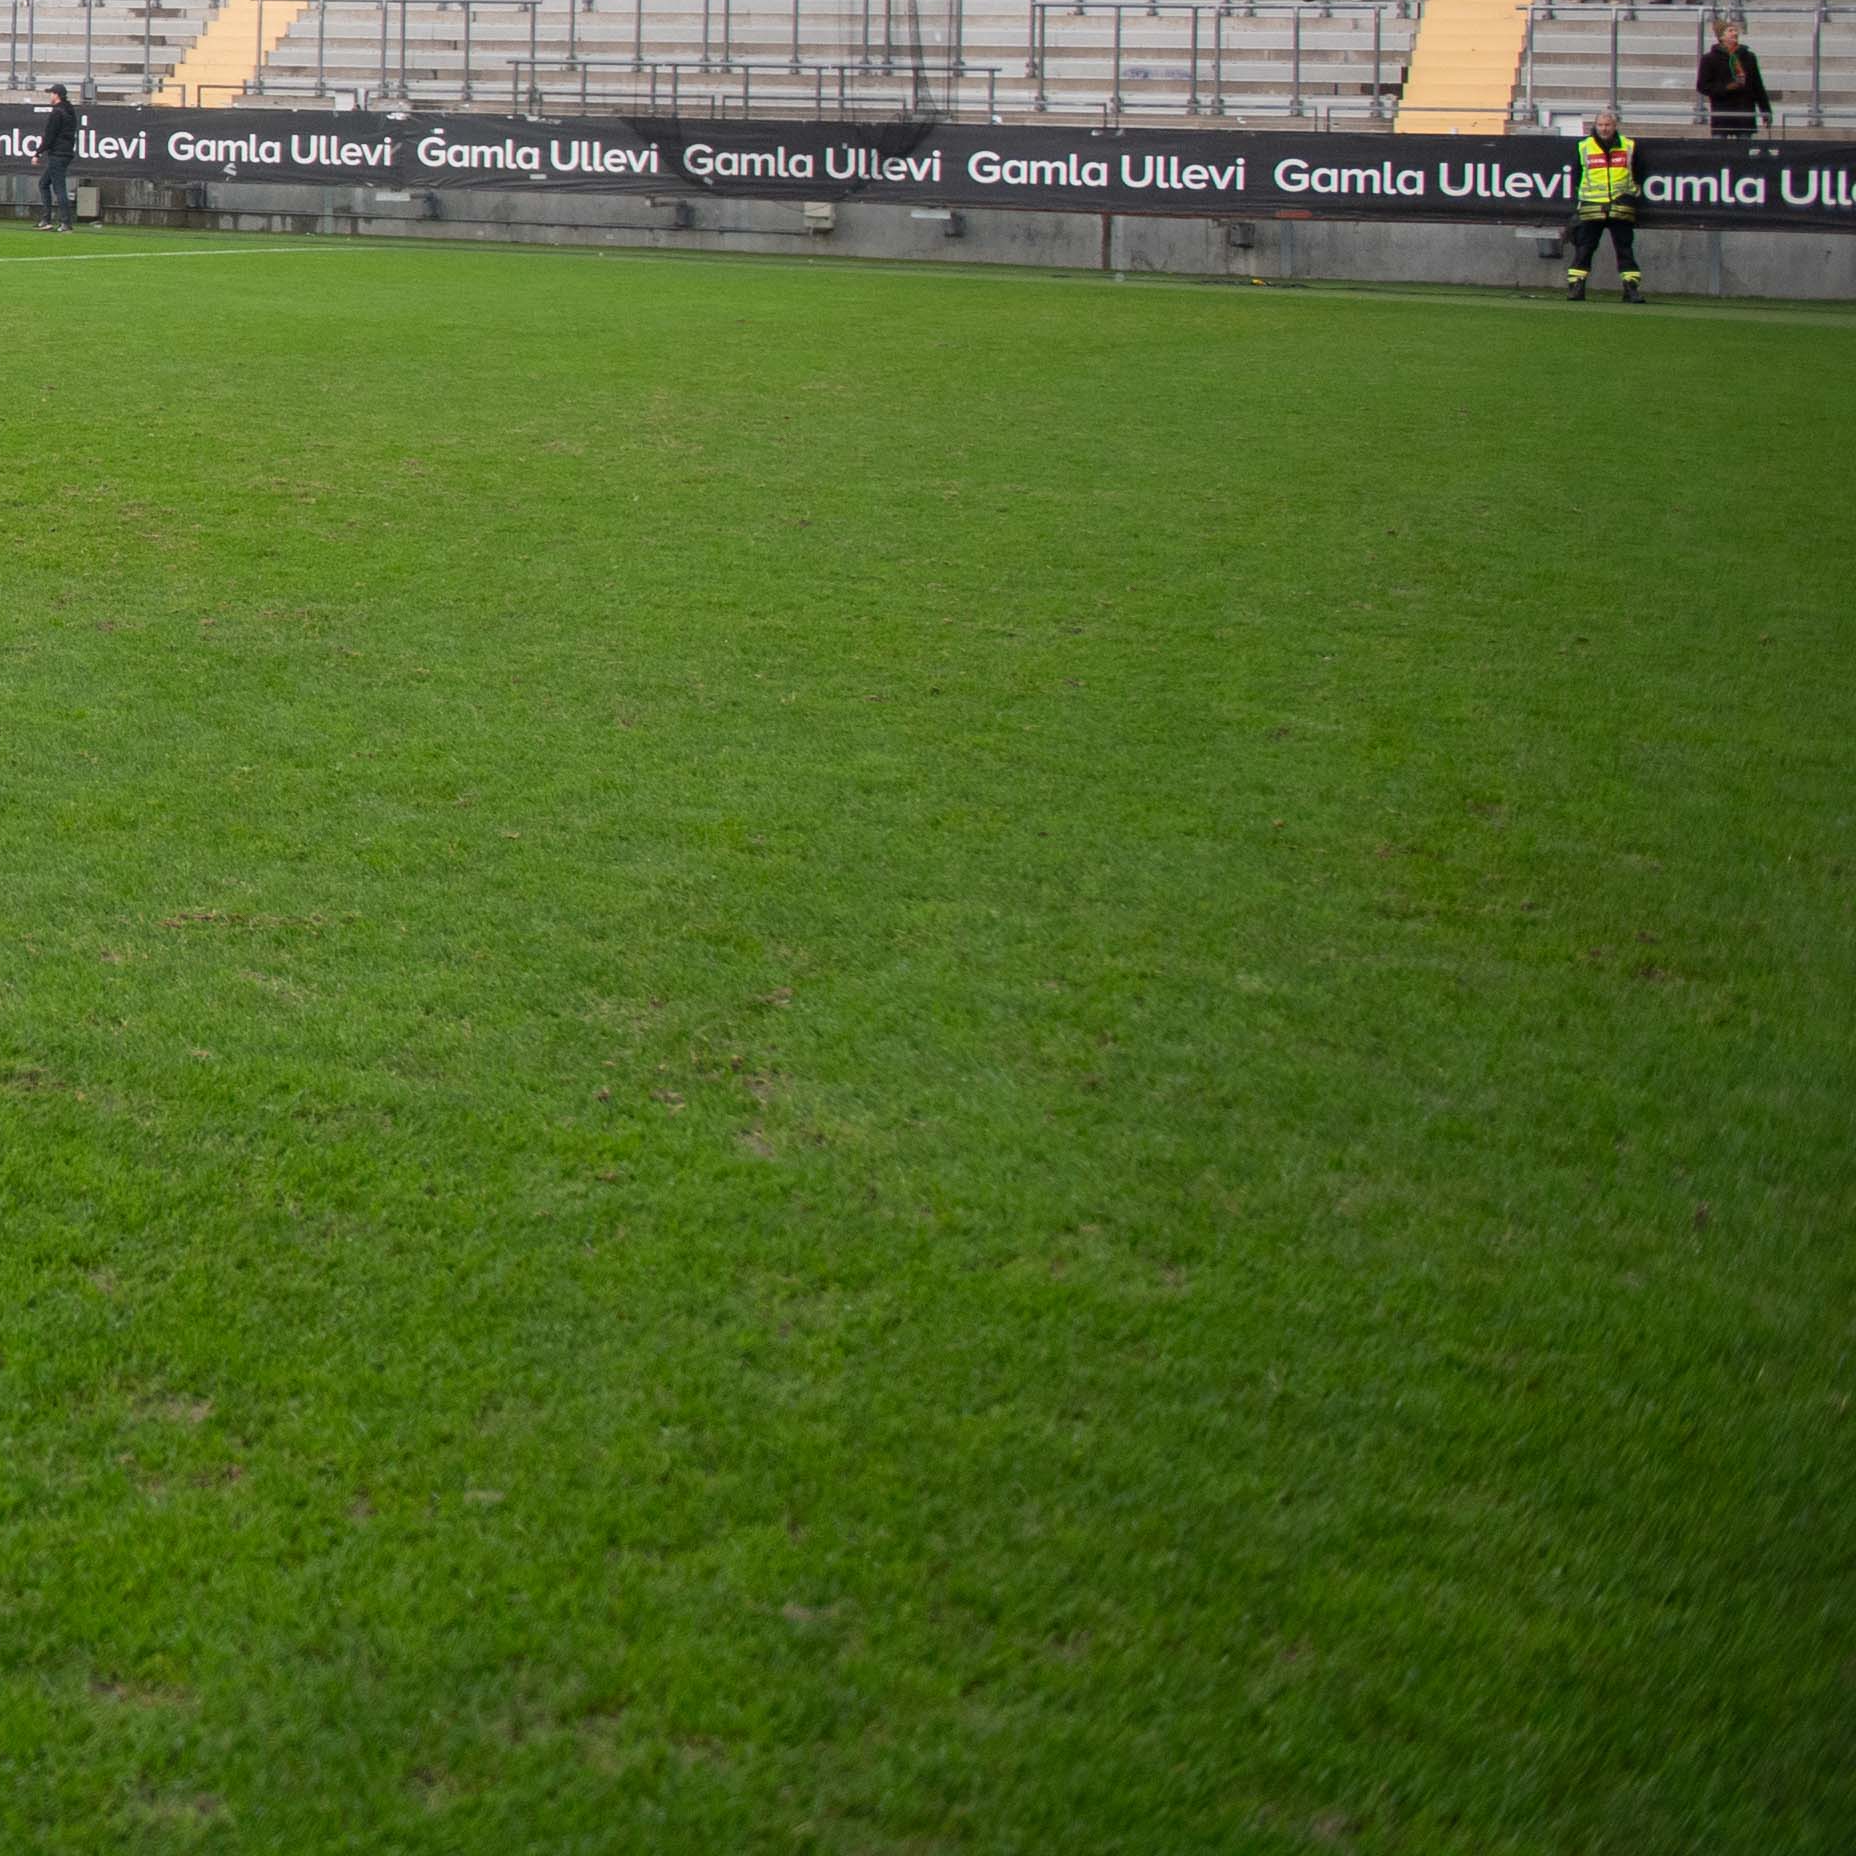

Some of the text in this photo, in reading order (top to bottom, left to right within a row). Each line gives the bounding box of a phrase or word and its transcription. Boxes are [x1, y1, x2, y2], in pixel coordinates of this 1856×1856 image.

[75, 129, 146, 160] llevi
[168, 131, 392, 168] Gamla Ullevi
[417, 136, 659, 175] Gamla Ullevi
[684, 143, 941, 182] Gamla Ullevi
[968, 150, 1246, 192] Gamla Ullevi
[1273, 158, 1571, 200] Gamla Ullevi
[1643, 167, 1856, 206] amla Ull
